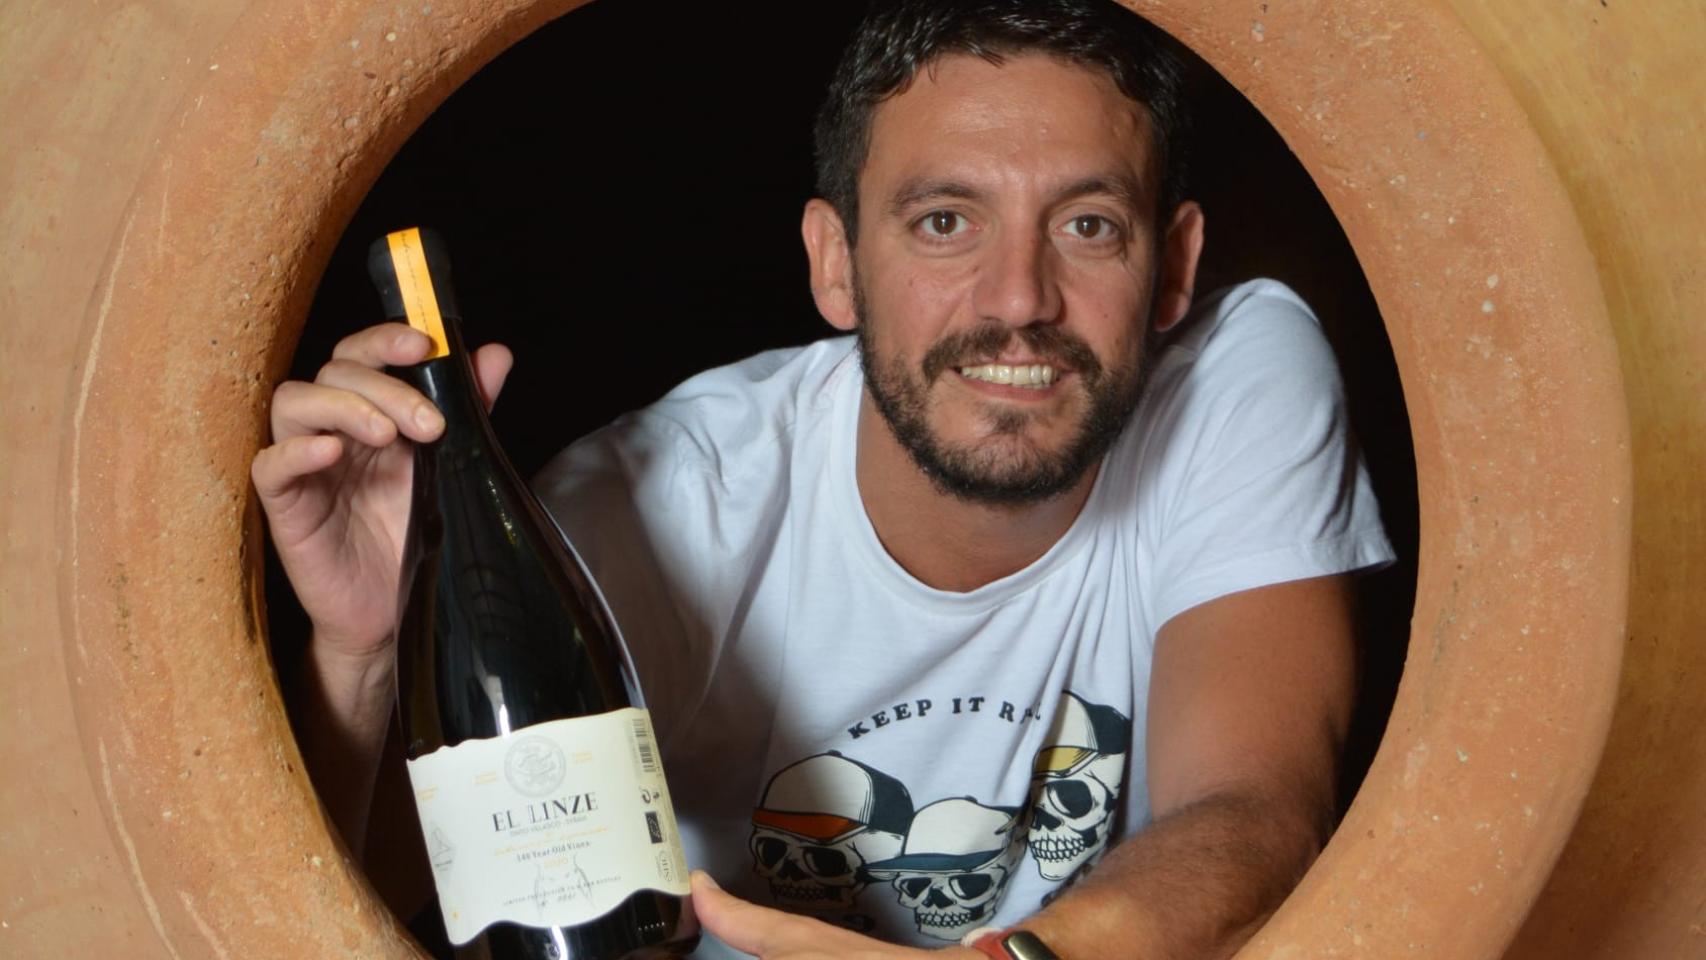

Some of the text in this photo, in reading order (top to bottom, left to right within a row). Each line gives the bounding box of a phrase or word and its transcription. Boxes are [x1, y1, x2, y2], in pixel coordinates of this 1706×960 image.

[848, 699, 933, 739] KEEP
[952, 697, 985, 714] IT
[492, 791, 599, 832] EL LINZE
